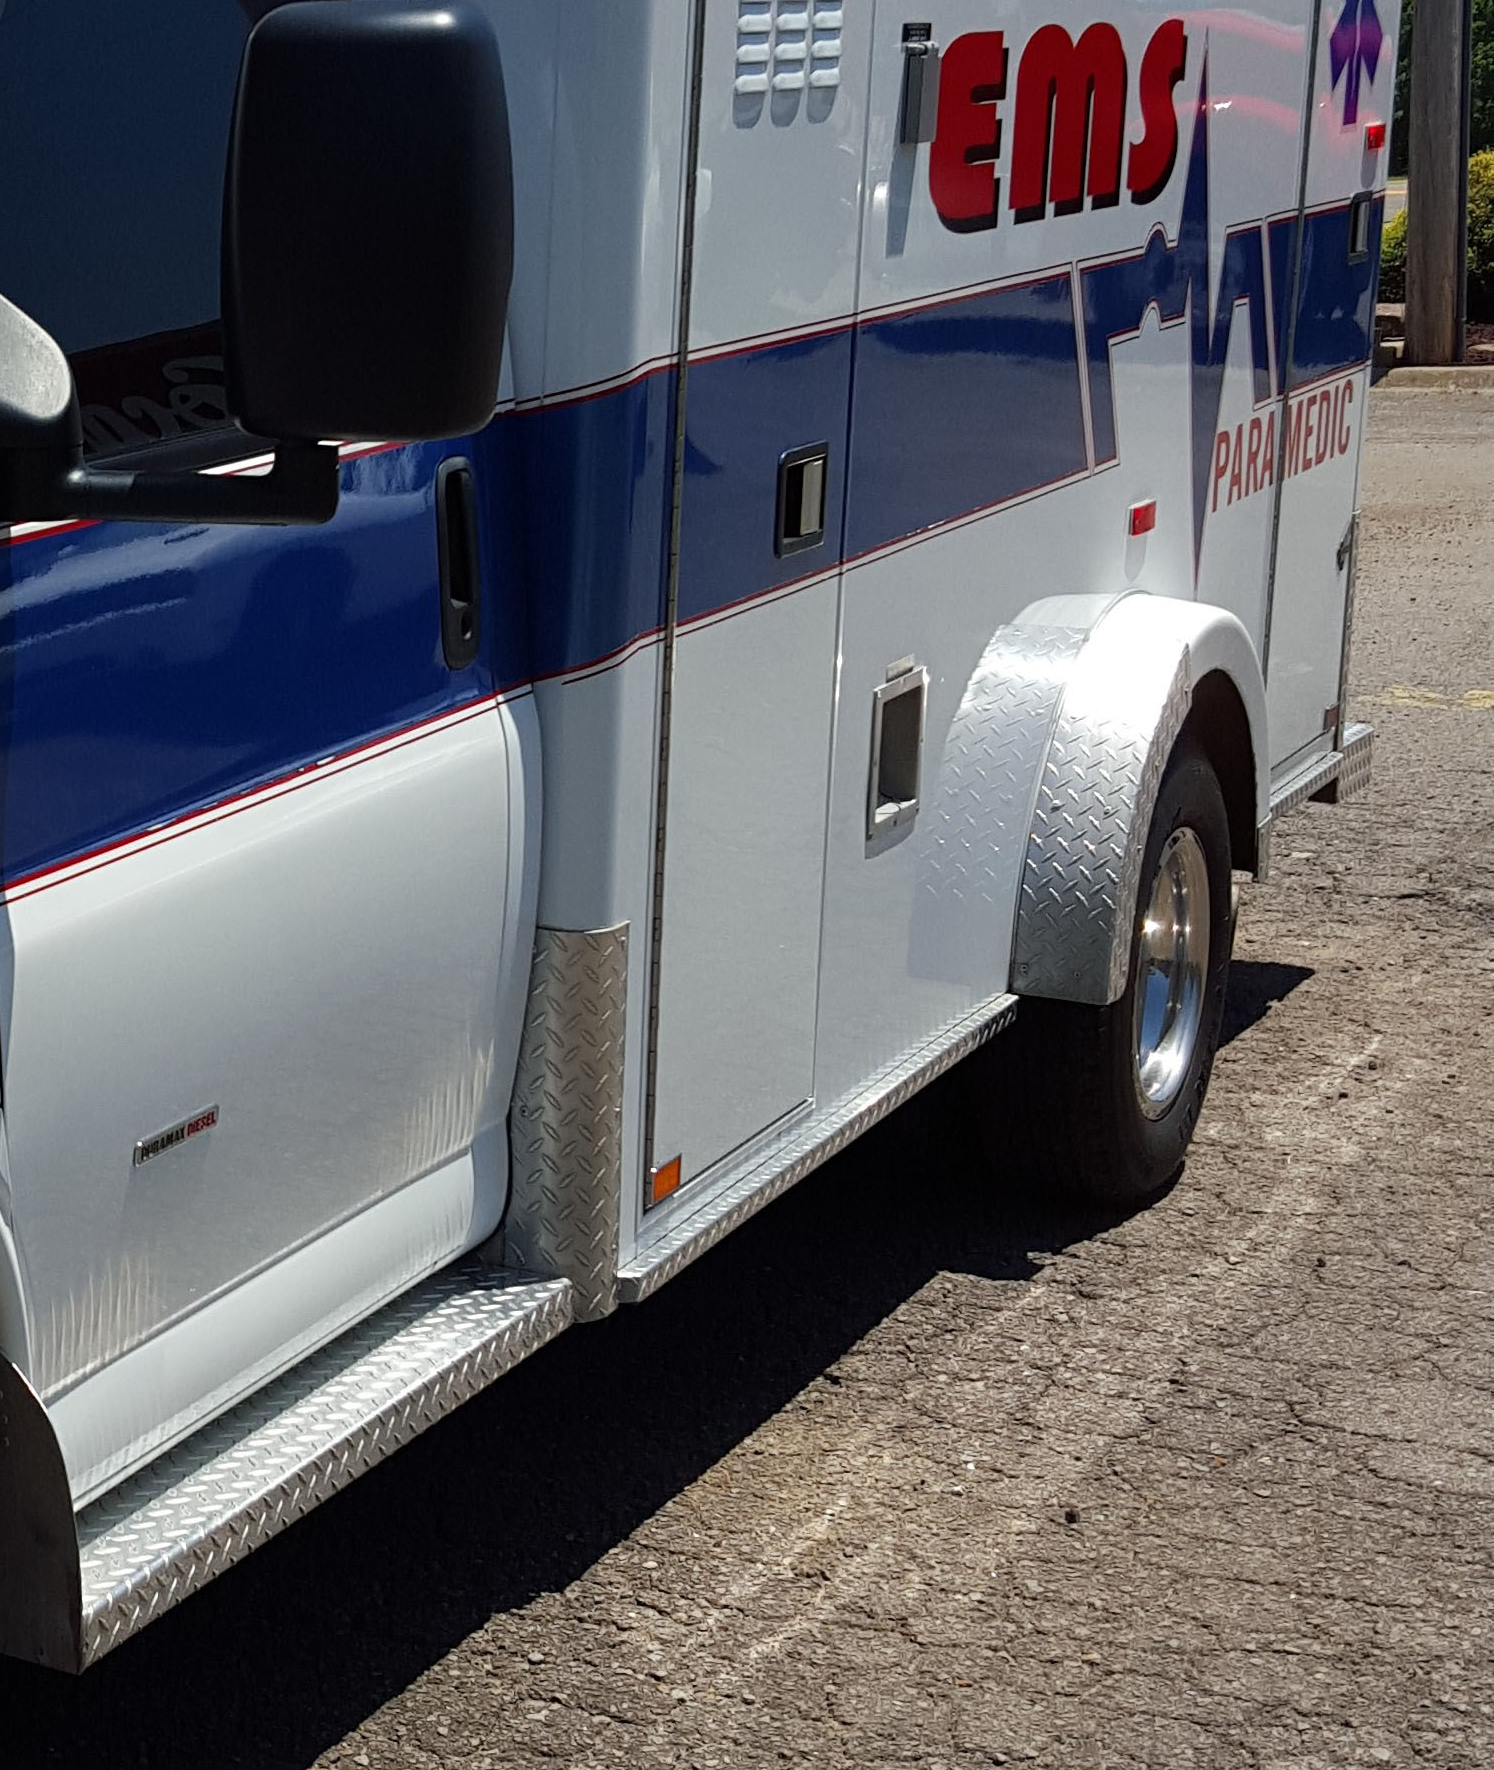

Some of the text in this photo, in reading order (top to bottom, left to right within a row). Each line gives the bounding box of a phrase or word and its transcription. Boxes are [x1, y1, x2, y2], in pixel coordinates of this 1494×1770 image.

[929, 19, 1188, 234] EMS
[1211, 379, 1354, 514] PARAMEDIC
[140, 1111, 216, 1160] DURAMAX DIESEL
